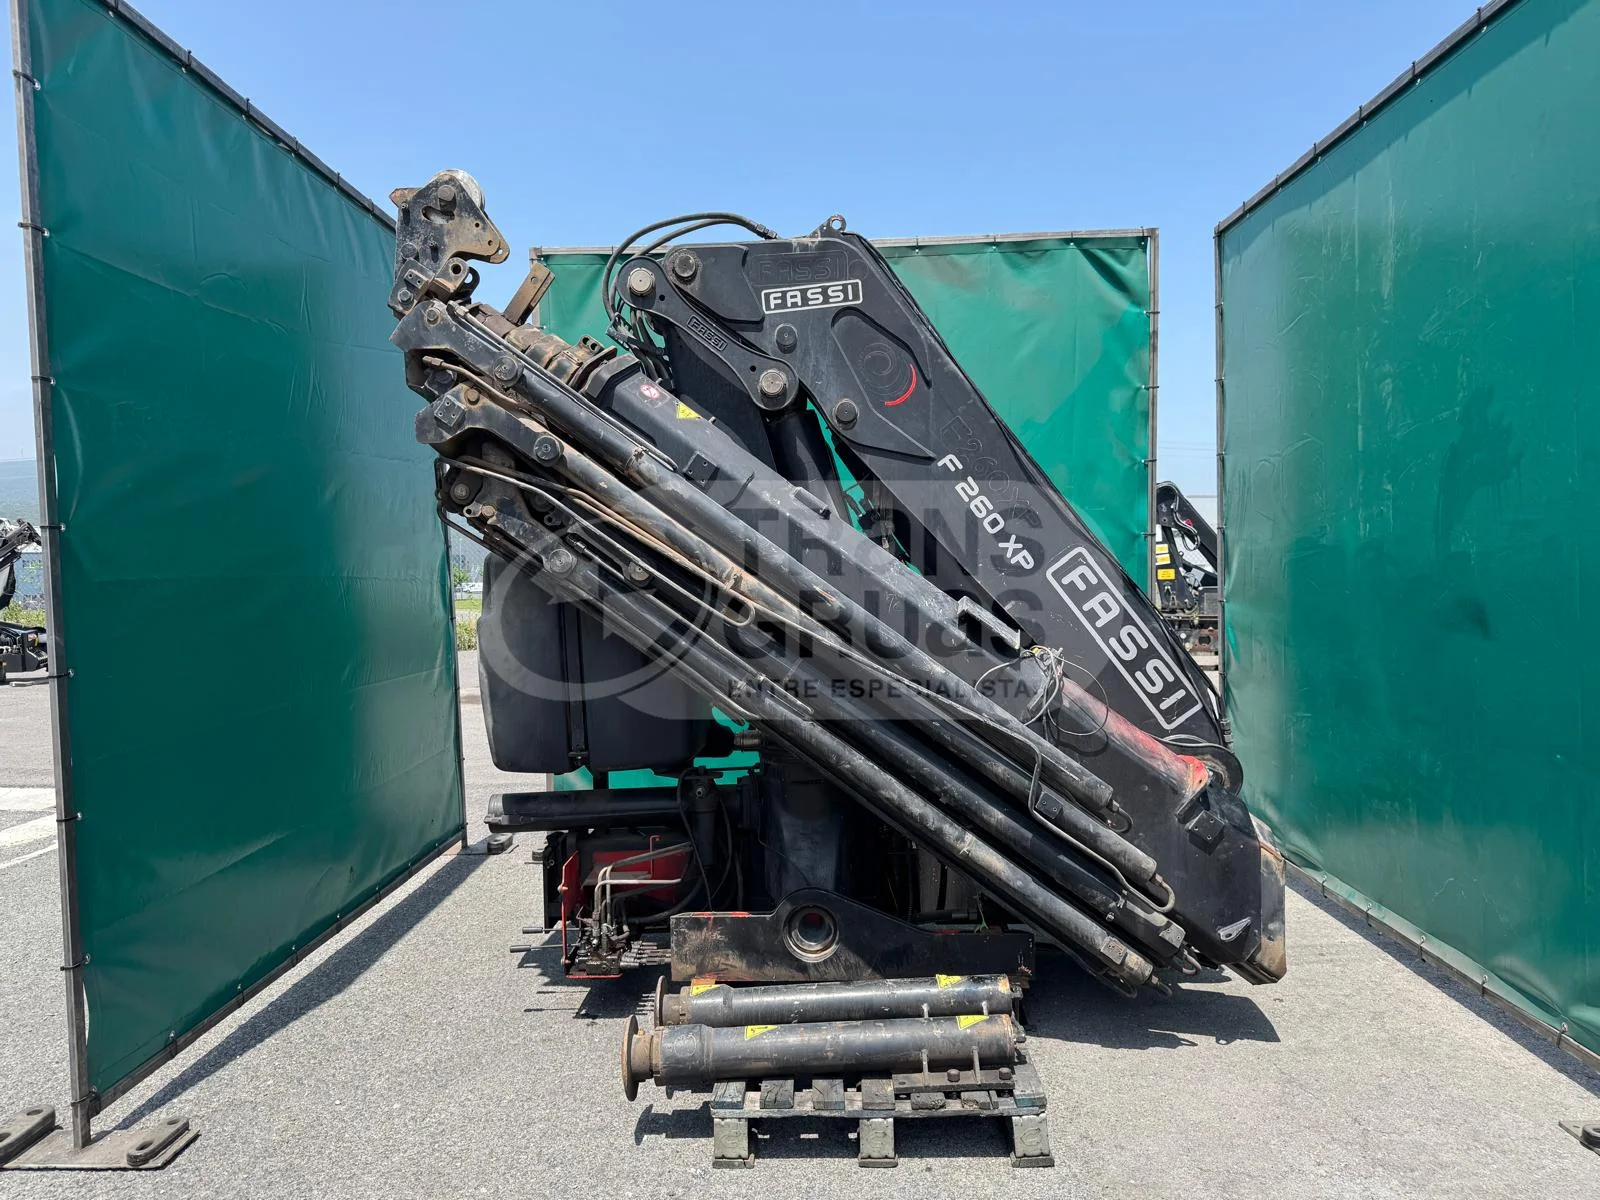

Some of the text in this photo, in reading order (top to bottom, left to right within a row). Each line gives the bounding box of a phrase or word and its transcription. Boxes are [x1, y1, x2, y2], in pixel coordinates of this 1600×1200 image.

[759, 257, 845, 282] FASSI
[769, 284, 853, 310] FASSI
[689, 319, 727, 351] FASSI
[937, 453, 1035, 570] F 260 XP
[1061, 565, 1186, 711] FASSI
